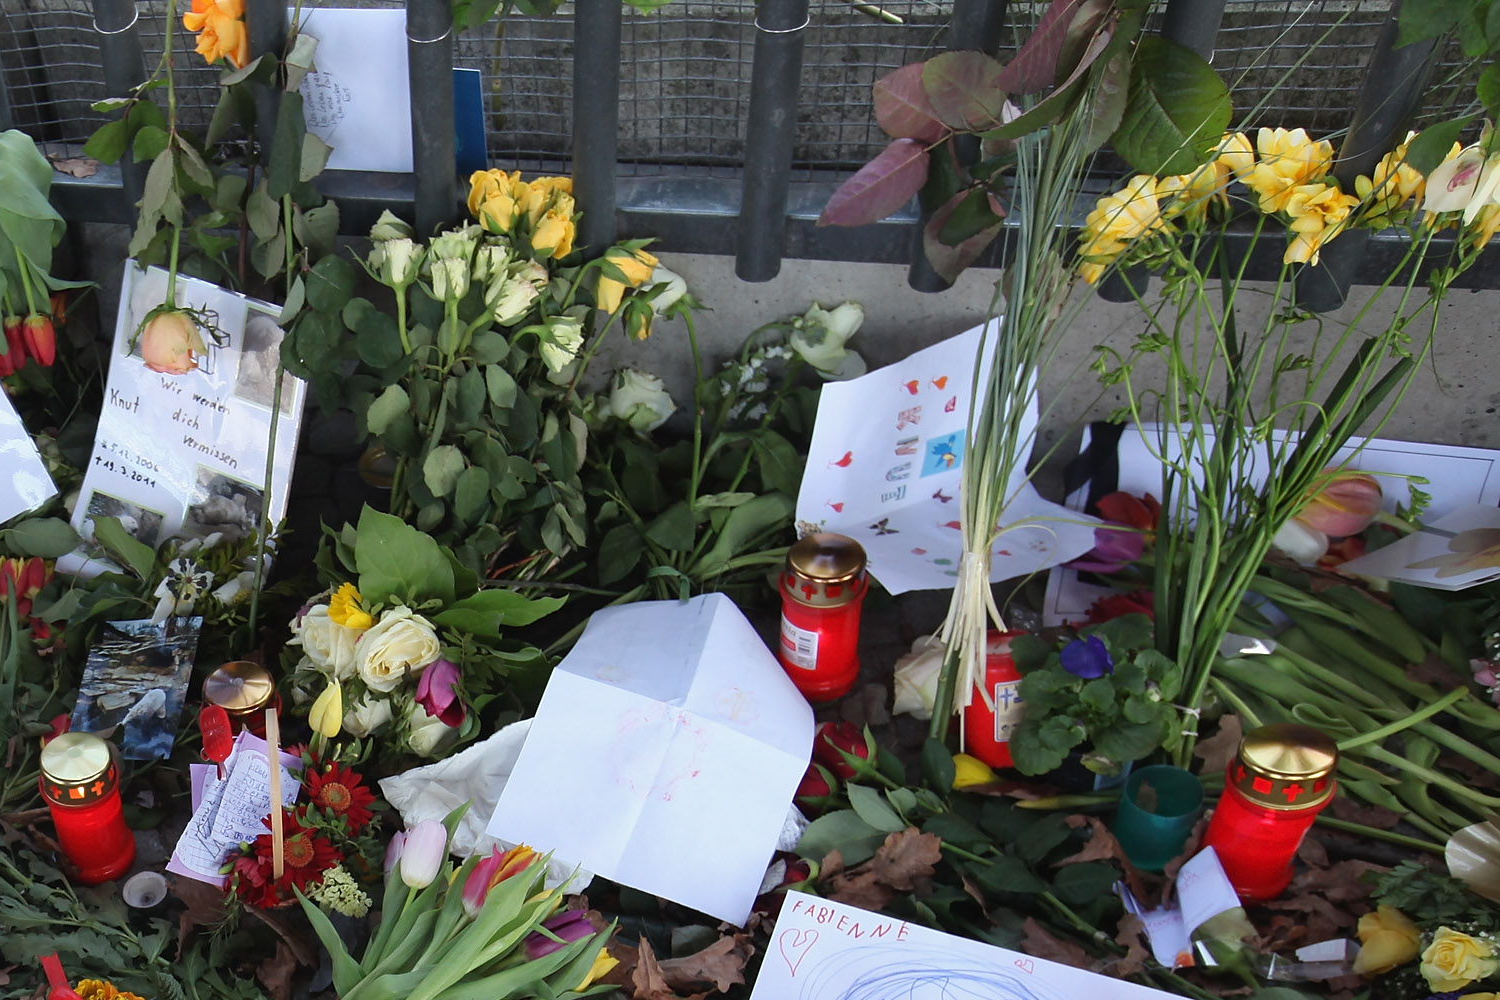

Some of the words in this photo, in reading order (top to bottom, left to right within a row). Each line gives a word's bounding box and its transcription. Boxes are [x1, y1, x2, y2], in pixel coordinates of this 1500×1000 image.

[110, 388, 140, 413] Knut
[161, 376, 182, 395] Wir
[192, 392, 231, 415] werden
[172, 408, 200, 430] dich
[183, 434, 238, 470] vermissen
[792, 900, 910, 941] FABIENNE
